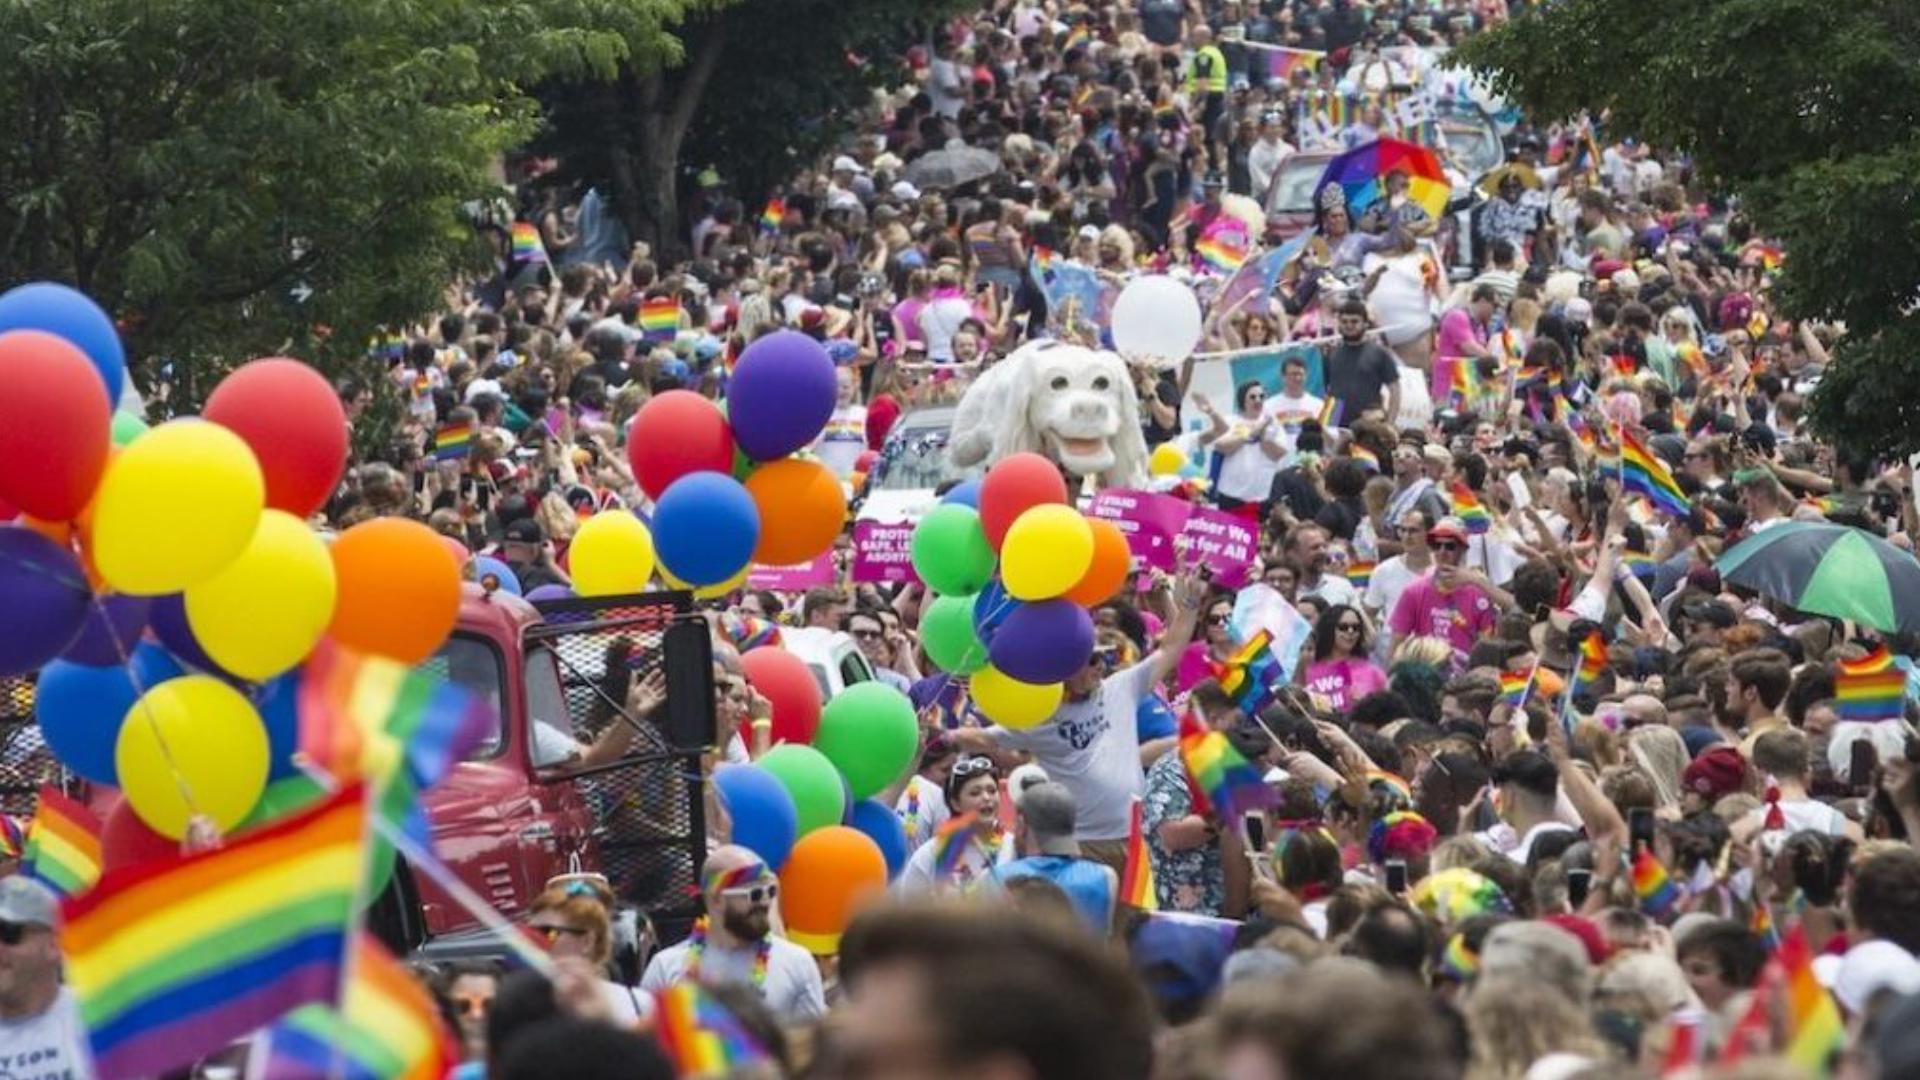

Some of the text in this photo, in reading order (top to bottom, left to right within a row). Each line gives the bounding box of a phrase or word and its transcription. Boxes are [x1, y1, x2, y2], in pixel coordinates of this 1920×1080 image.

[1228, 524, 1252, 545] We
[1197, 536, 1223, 554] for
[1222, 543, 1248, 562] All
